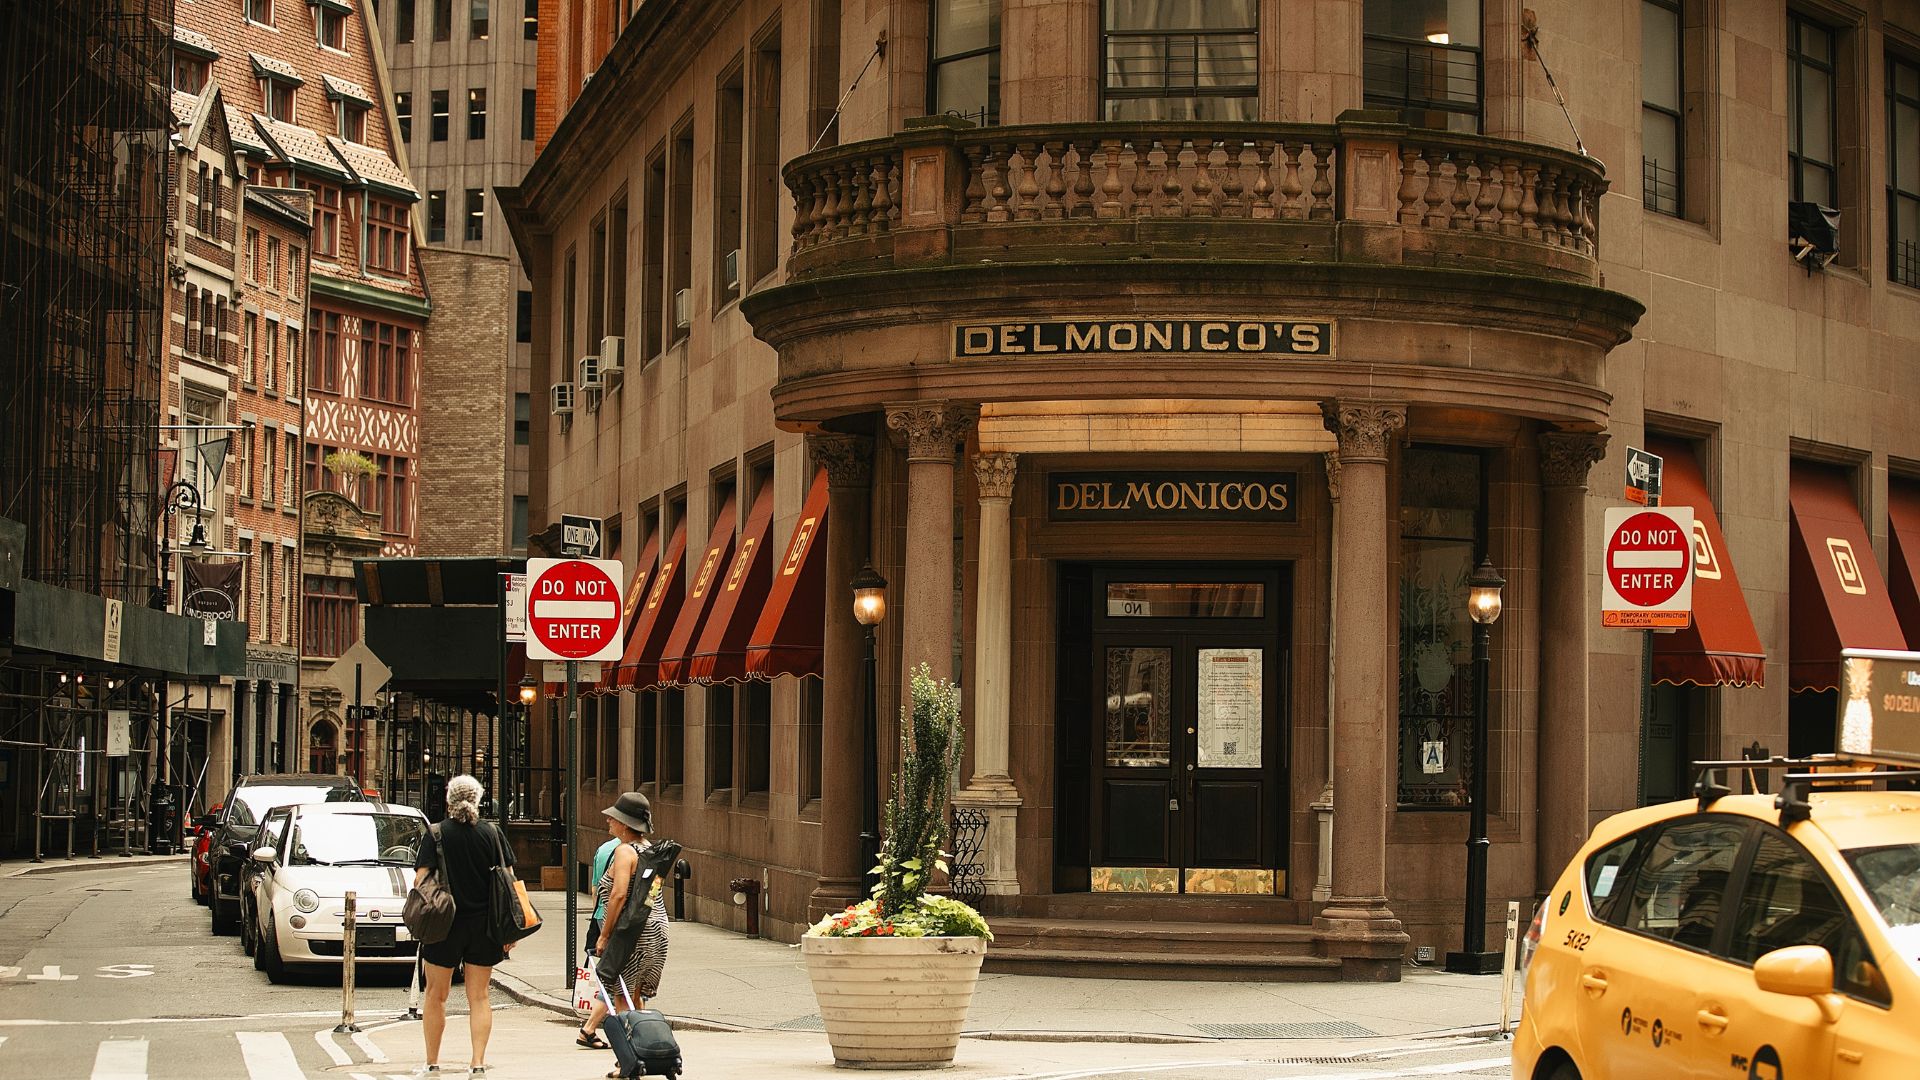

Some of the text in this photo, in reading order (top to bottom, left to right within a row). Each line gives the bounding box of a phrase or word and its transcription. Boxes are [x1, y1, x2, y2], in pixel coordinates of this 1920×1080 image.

[964, 322, 1321, 354] DELMONICO'S
[1633, 461, 1644, 479] ONE
[1056, 481, 1288, 512] DELMONICOS
[566, 527, 596, 546] ONE WAY
[1621, 530, 1677, 545] DO NOT
[542, 580, 607, 596] DO NOT
[1621, 573, 1673, 589] ENTER
[185, 607, 232, 620] UNDERDOG
[549, 623, 601, 639] ENTER
[1426, 745, 1440, 764] A
[578, 996, 593, 1011] in.
[1731, 1053, 1748, 1072] NYC
